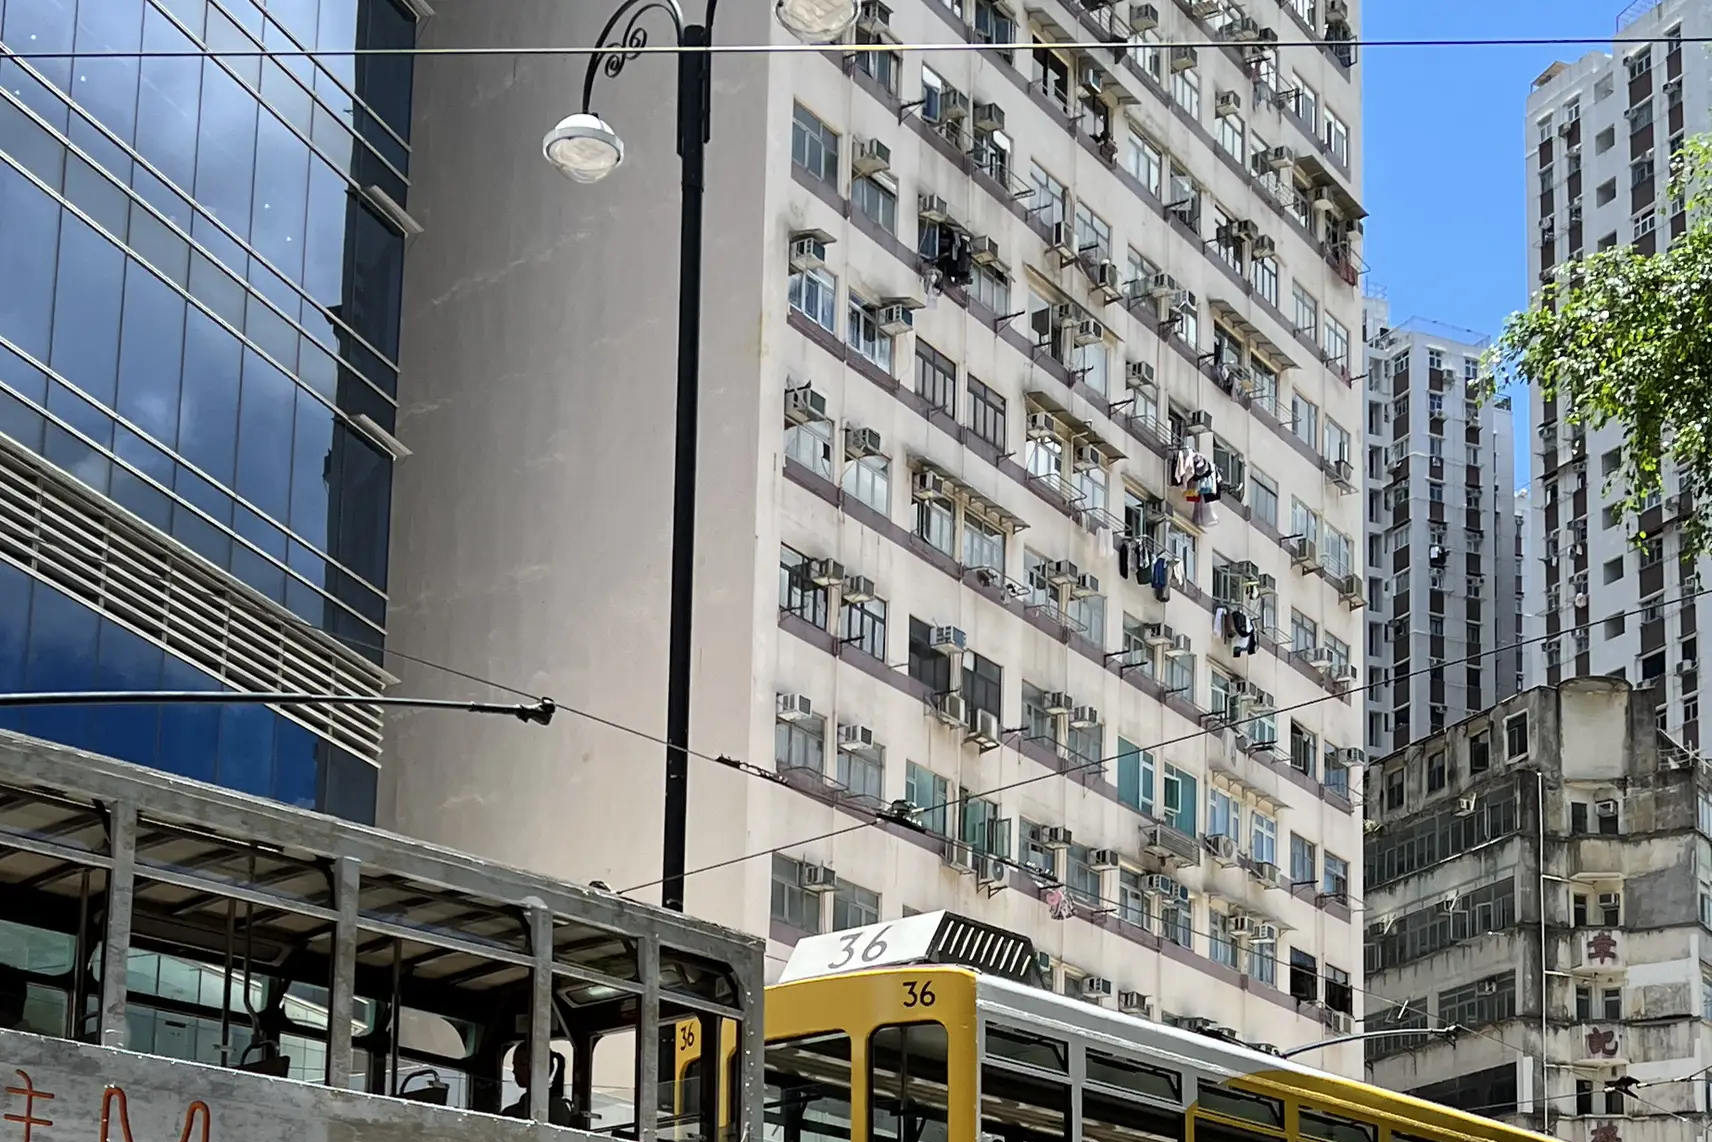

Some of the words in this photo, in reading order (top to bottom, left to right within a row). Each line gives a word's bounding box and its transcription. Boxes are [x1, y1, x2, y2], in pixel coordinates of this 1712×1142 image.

[827, 924, 892, 970] 36
[903, 981, 935, 1007] 36
[680, 1021, 695, 1051] 36
